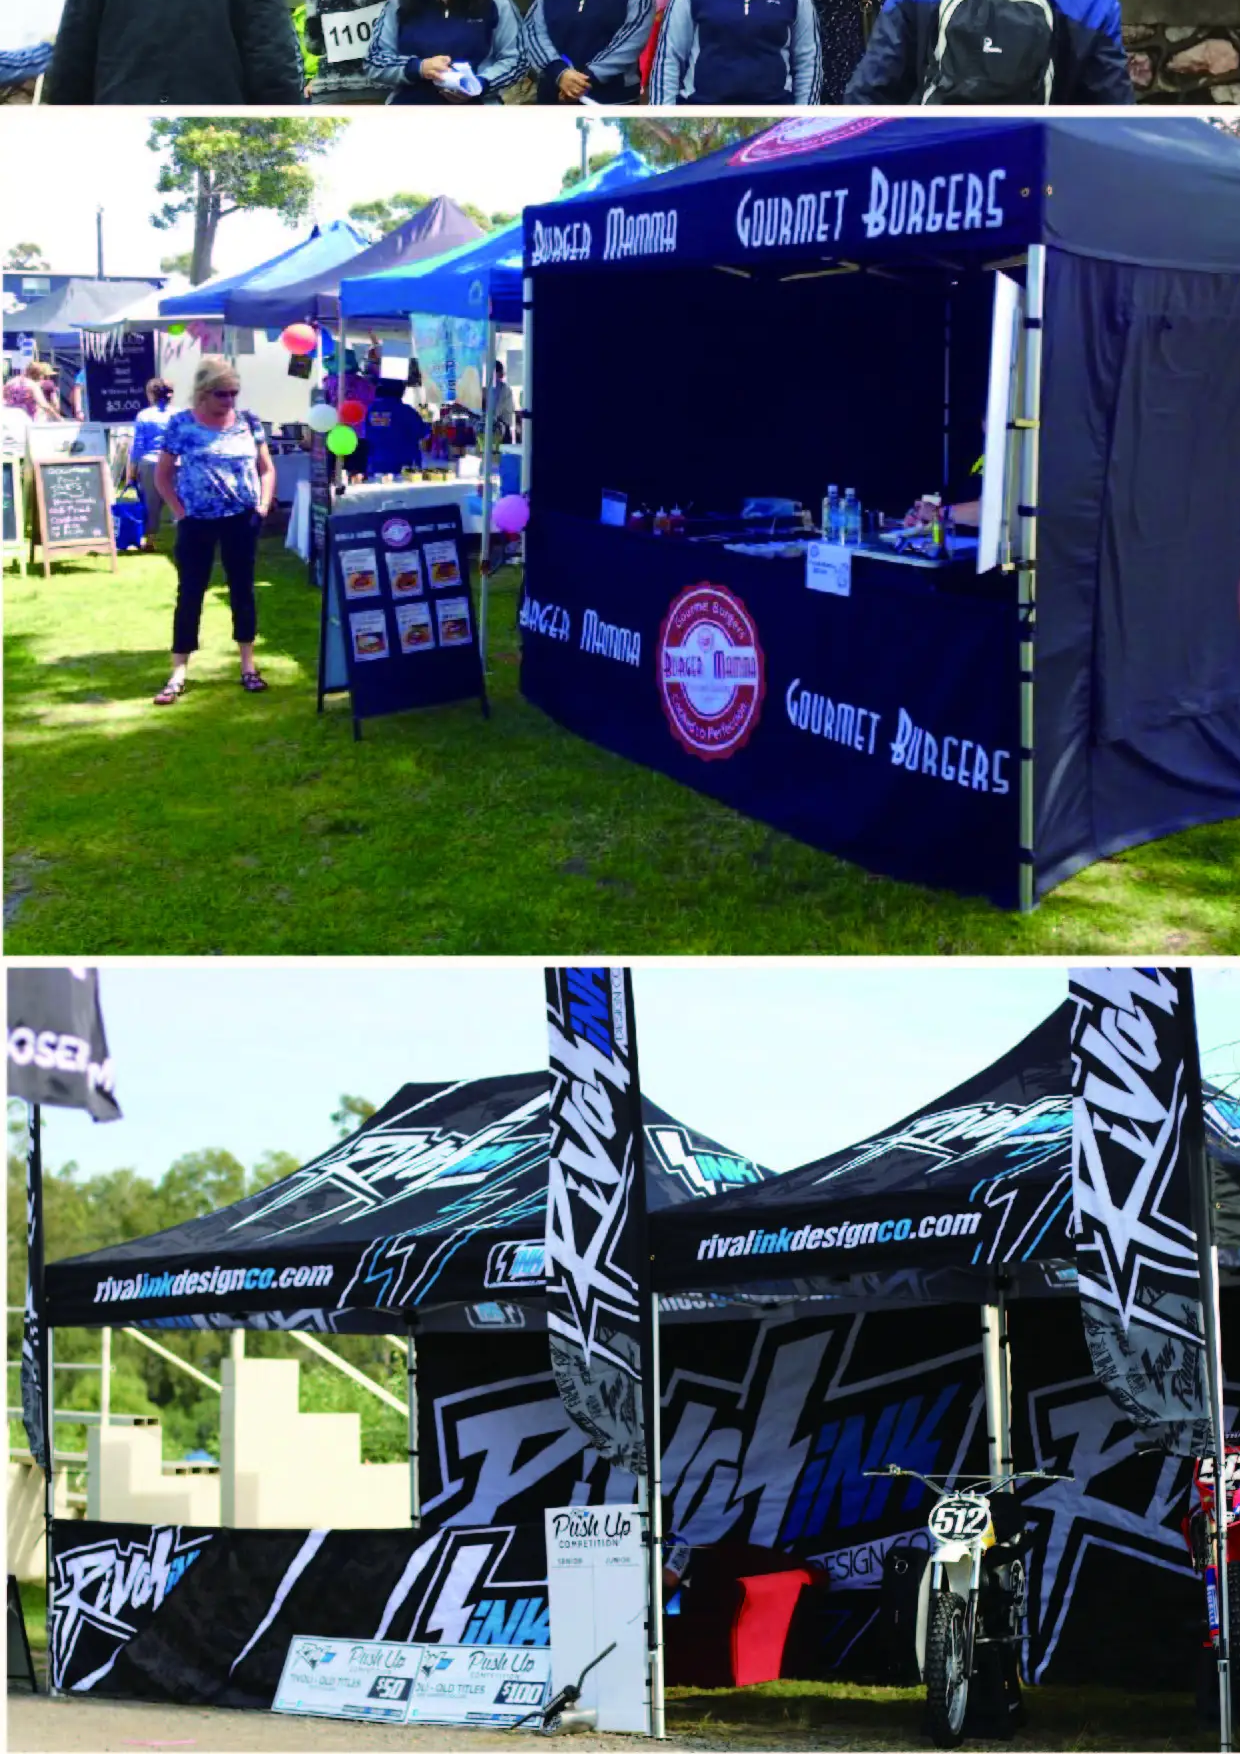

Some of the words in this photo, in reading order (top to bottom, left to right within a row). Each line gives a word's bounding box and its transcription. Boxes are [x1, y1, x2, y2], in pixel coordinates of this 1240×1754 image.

[531, 219, 592, 266] BURGER
[603, 206, 678, 260] MAMMA
[736, 188, 849, 248] GOURMET
[862, 166, 1006, 239] BURGERS
[580, 608, 641, 667] MAMMA
[786, 677, 881, 755] GOURMET
[890, 707, 1010, 794] BURGERS
[695, 1210, 982, 1262] rivalinkdesignco.com
[94, 1263, 334, 1303] rivalinkdesignco.com
[552, 1512, 599, 1540] Push
[603, 1510, 633, 1537] Up
[934, 1507, 987, 1536] 512
[558, 1539, 620, 1549] COMPETITION
[349, 1646, 381, 1668] Push
[384, 1649, 407, 1670] Up
[468, 1650, 508, 1672] Push
[510, 1652, 536, 1673] Up
[376, 1677, 406, 1699] $50
[457, 1685, 486, 1694] TITLES
[503, 1682, 543, 1704] $100
